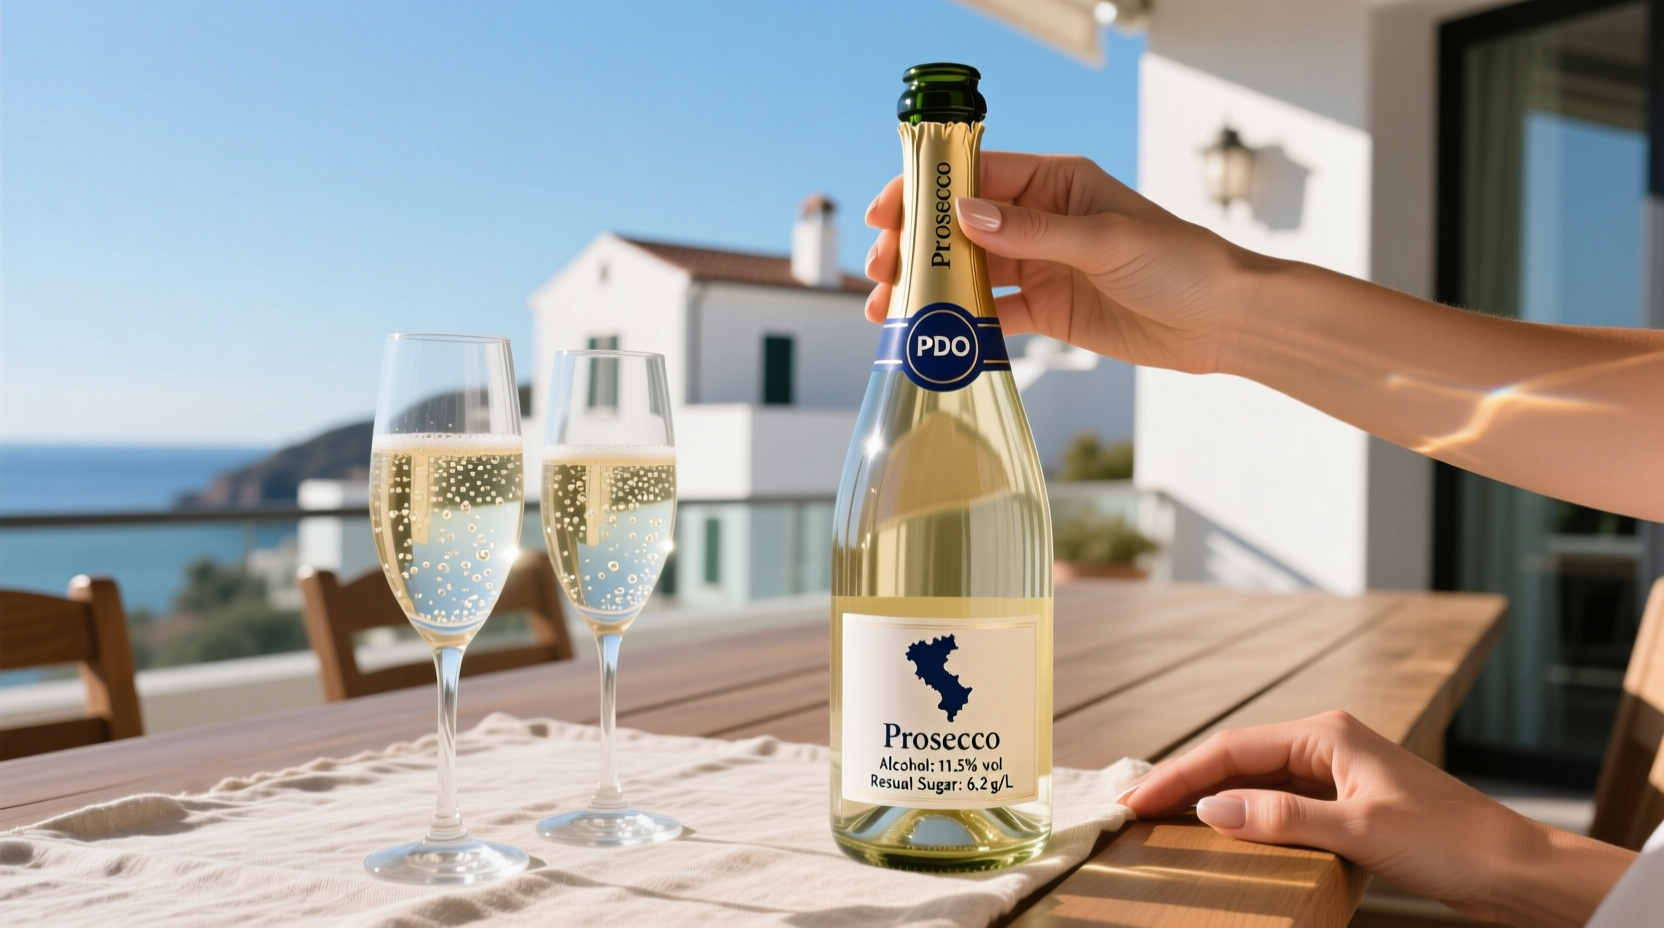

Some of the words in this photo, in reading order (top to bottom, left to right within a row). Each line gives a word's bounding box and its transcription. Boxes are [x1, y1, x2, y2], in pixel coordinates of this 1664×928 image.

[931, 162, 952, 270] Prosecco
[916, 335, 971, 357] PDO
[883, 722, 1001, 751] Prosecco
[879, 756, 935, 773] Alcohol:
[939, 757, 978, 773] 11.5%
[982, 756, 1004, 772] vol
[870, 774, 913, 791] Resual
[917, 776, 963, 795] Sugar:
